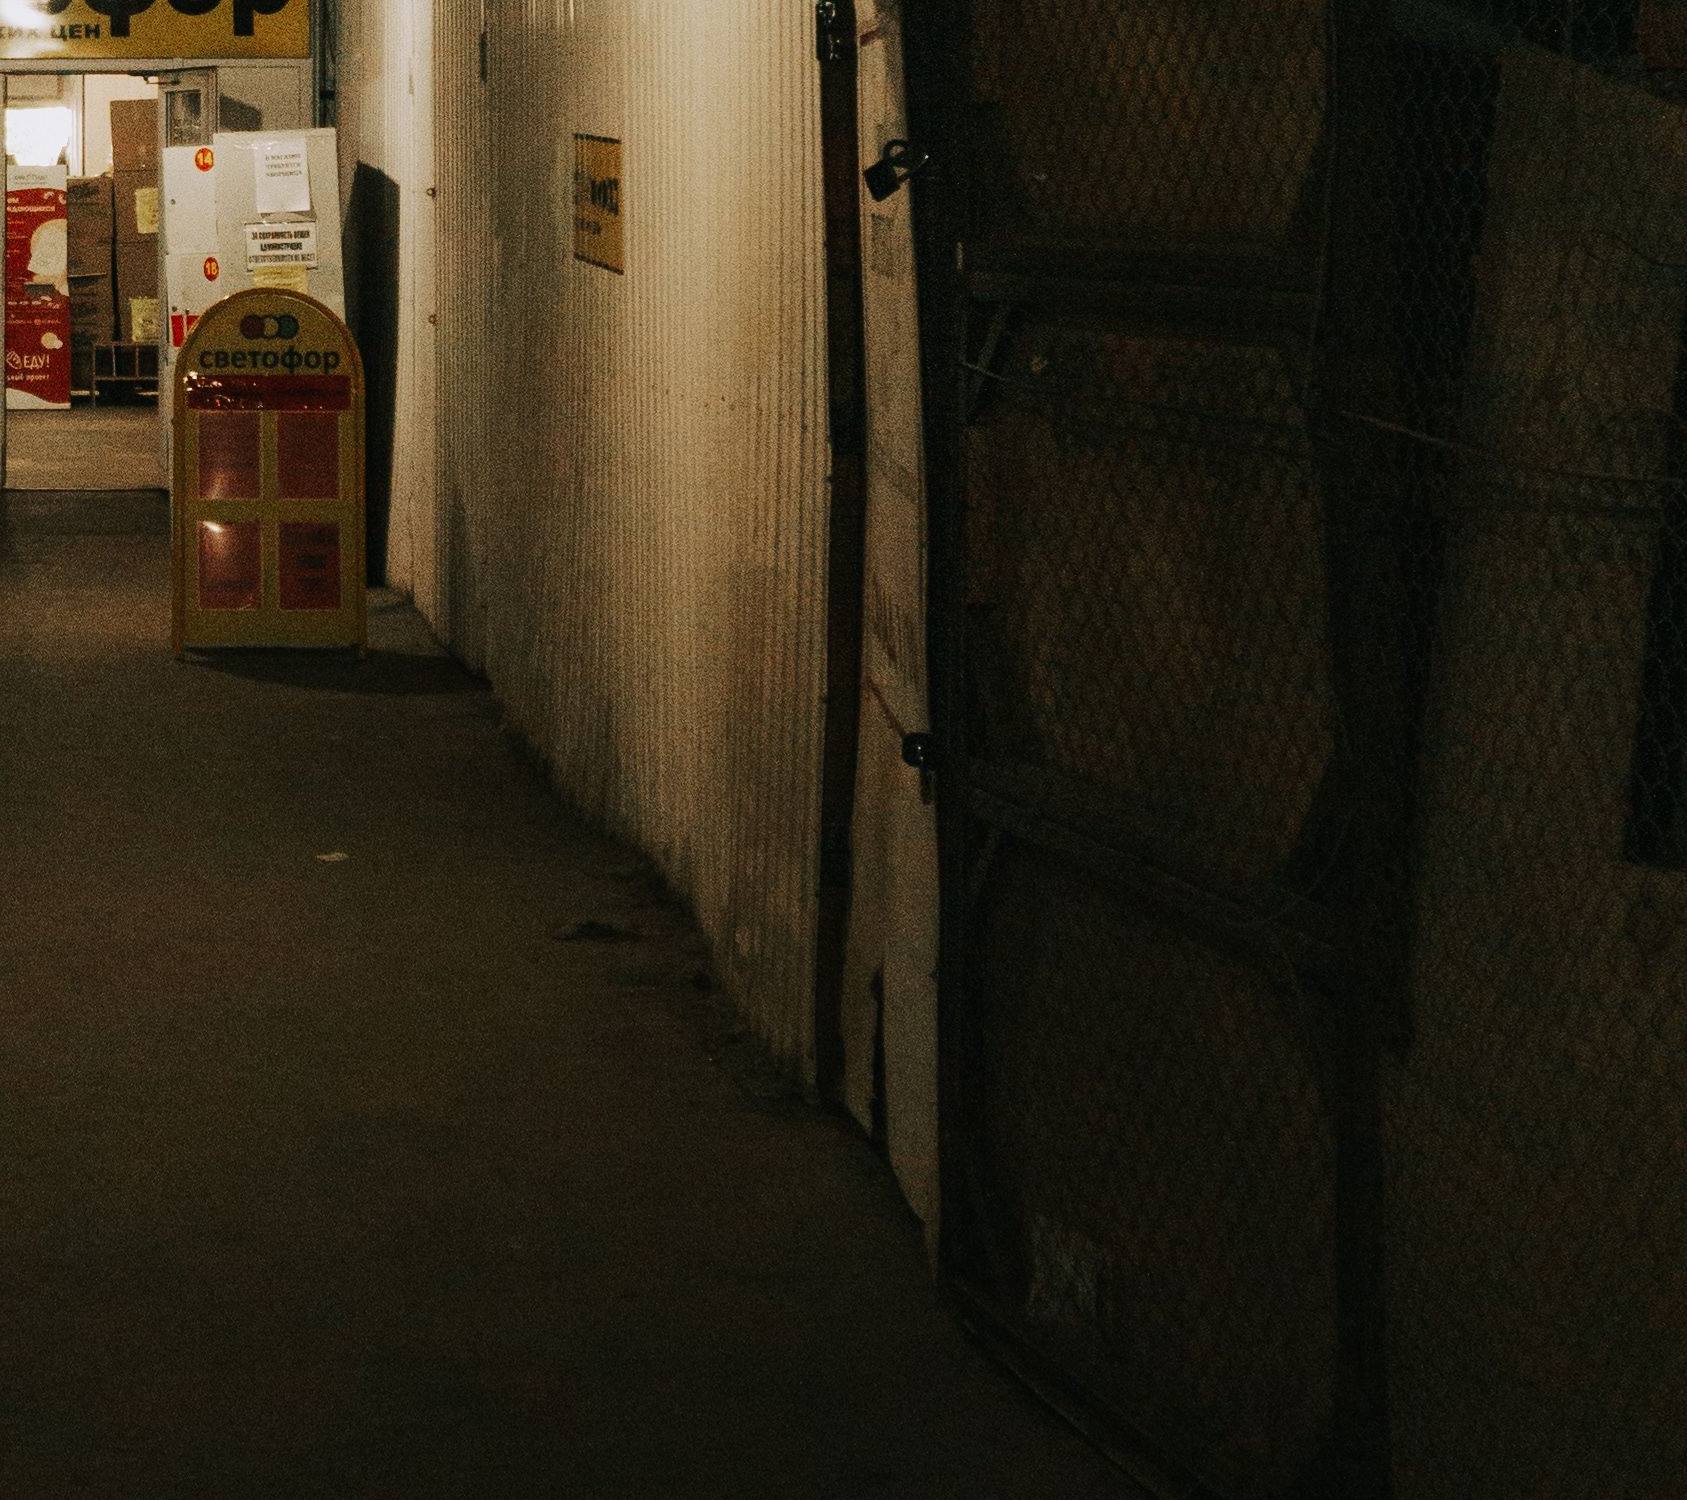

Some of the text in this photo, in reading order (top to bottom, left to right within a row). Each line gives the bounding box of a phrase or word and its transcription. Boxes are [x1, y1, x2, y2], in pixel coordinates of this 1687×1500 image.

[50, 23, 102, 43] ЦЕН
[197, 153, 213, 166] 14
[206, 261, 218, 275] 18
[199, 348, 341, 374] светофор
